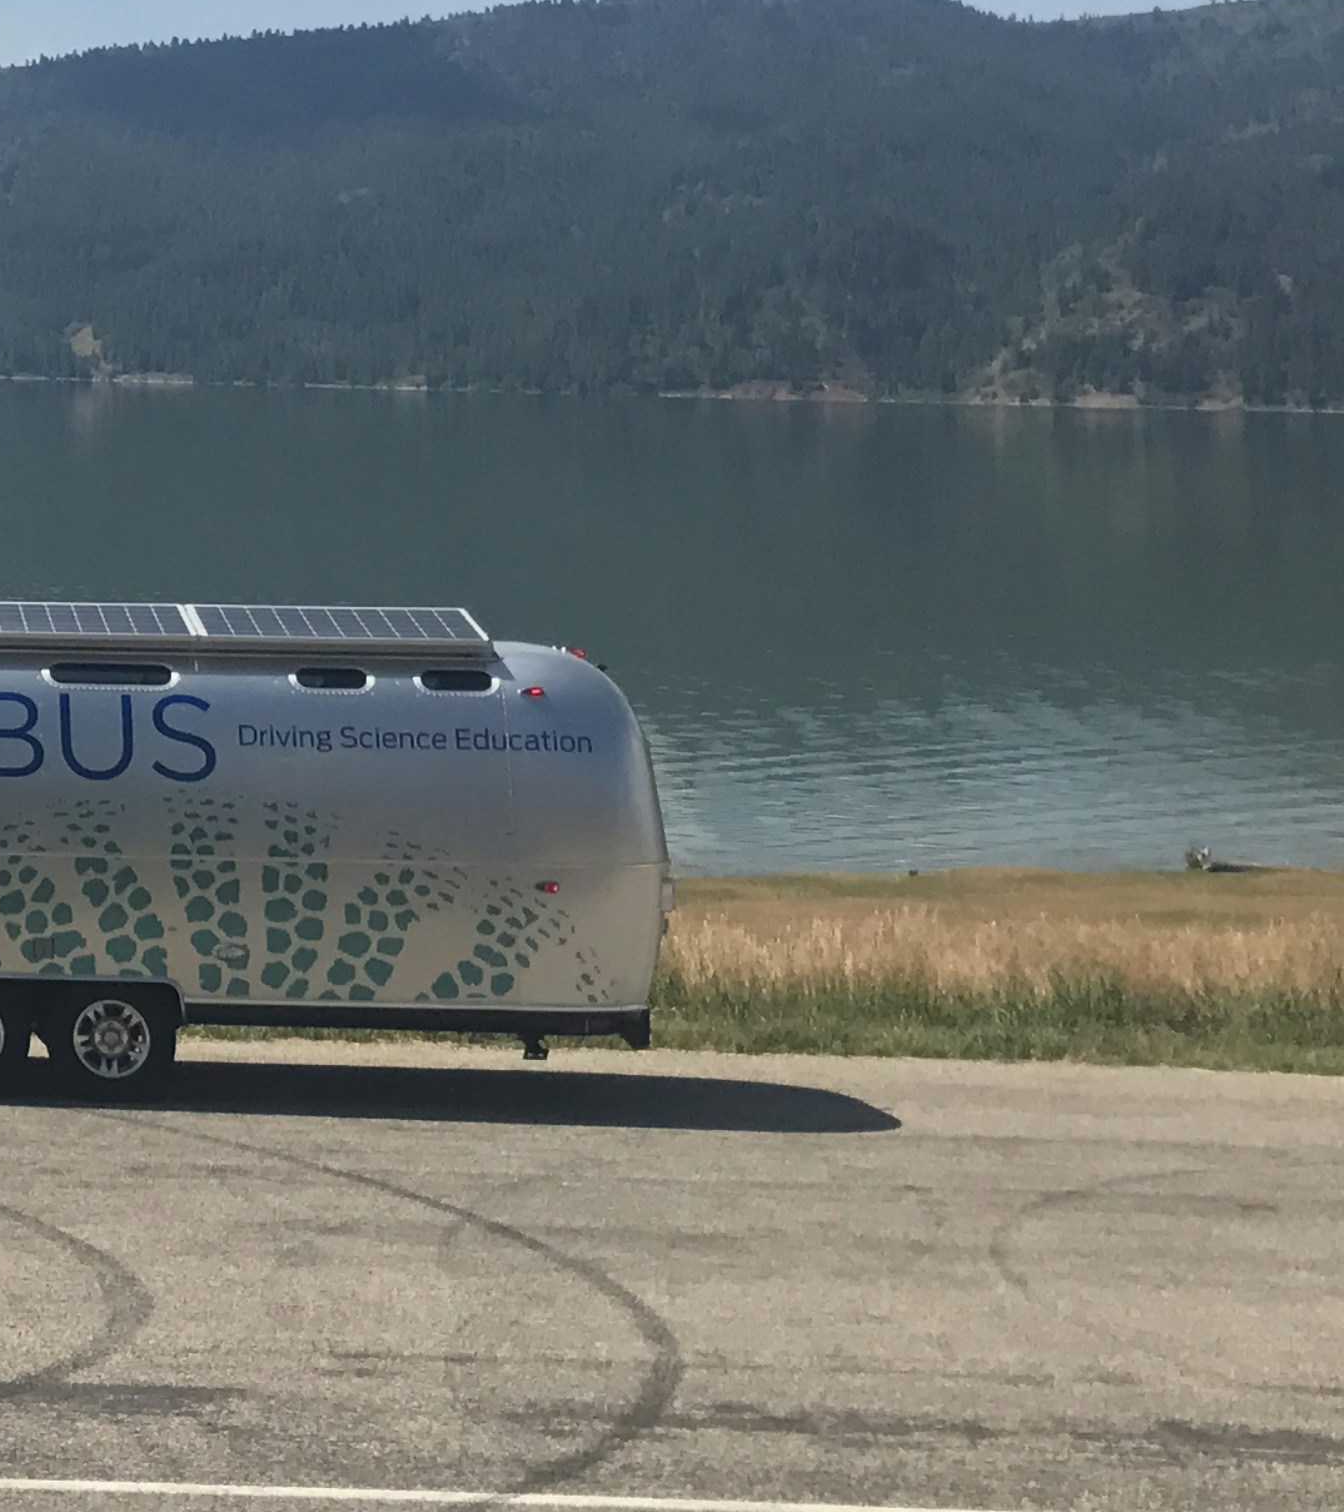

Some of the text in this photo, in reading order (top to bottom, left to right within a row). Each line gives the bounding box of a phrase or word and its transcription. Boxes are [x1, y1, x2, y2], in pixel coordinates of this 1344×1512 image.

[238, 724, 593, 754] Driving Science Education
